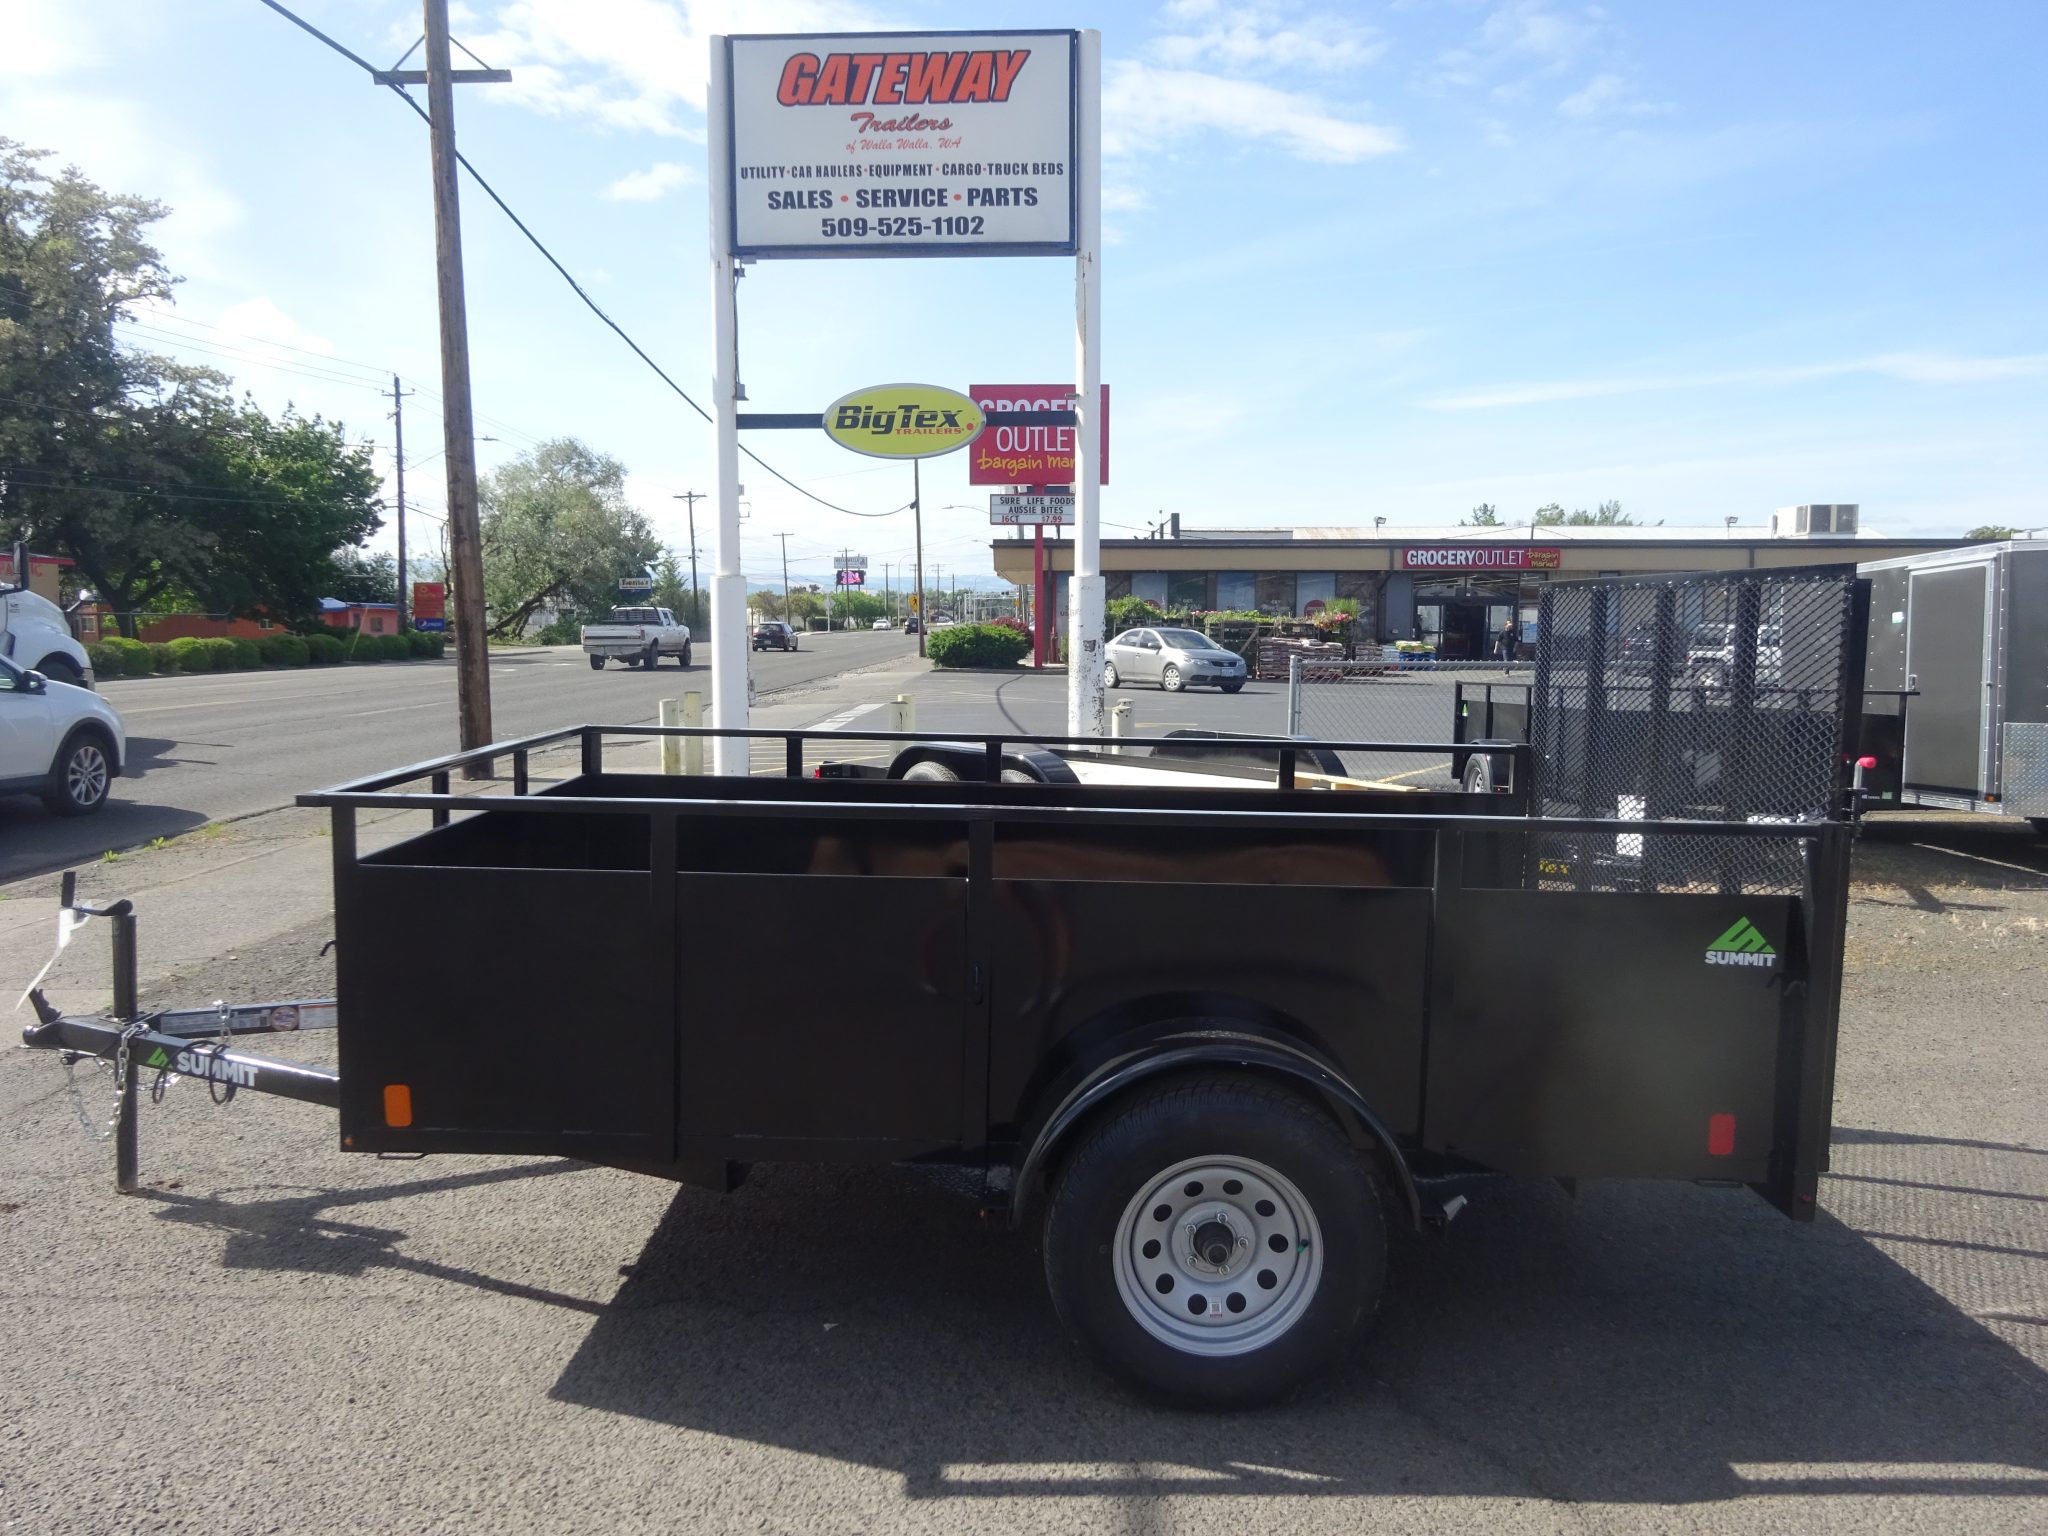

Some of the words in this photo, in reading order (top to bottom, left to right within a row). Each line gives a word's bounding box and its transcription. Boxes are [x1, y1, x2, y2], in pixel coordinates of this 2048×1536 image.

[776, 49, 1031, 107] GATEWAY
[850, 111, 953, 134] Trailers
[845, 139, 858, 154] of
[860, 138, 893, 151] Walla
[938, 136, 963, 149] WA
[740, 165, 786, 180] UTILITY
[791, 165, 812, 179] CAR
[815, 164, 863, 178] HAULERS
[868, 163, 933, 178] EQUIPMENT
[942, 162, 982, 176] CARGO
[987, 162, 1029, 176] TRUCK
[1032, 161, 1064, 176] BEDS
[767, 189, 834, 210] SALES
[856, 187, 949, 208] SERVICE
[967, 186, 1038, 207] PARTS
[821, 215, 985, 237] 509-525-1102
[977, 448, 1042, 477] bargain
[1047, 455, 1076, 470] mar
[1000, 496, 1020, 505] SURE
[1027, 496, 1045, 505] LIFE
[1050, 496, 1076, 505] FOODS
[1002, 515, 1020, 523] 16CT
[1008, 506, 1037, 514] AUSSIE
[1041, 506, 1064, 514] BITES
[1526, 548, 1559, 561] bargain
[1531, 558, 1557, 567] market
[1704, 950, 1776, 967] SUMMIT
[176, 1051, 259, 1087] SUMMIT
